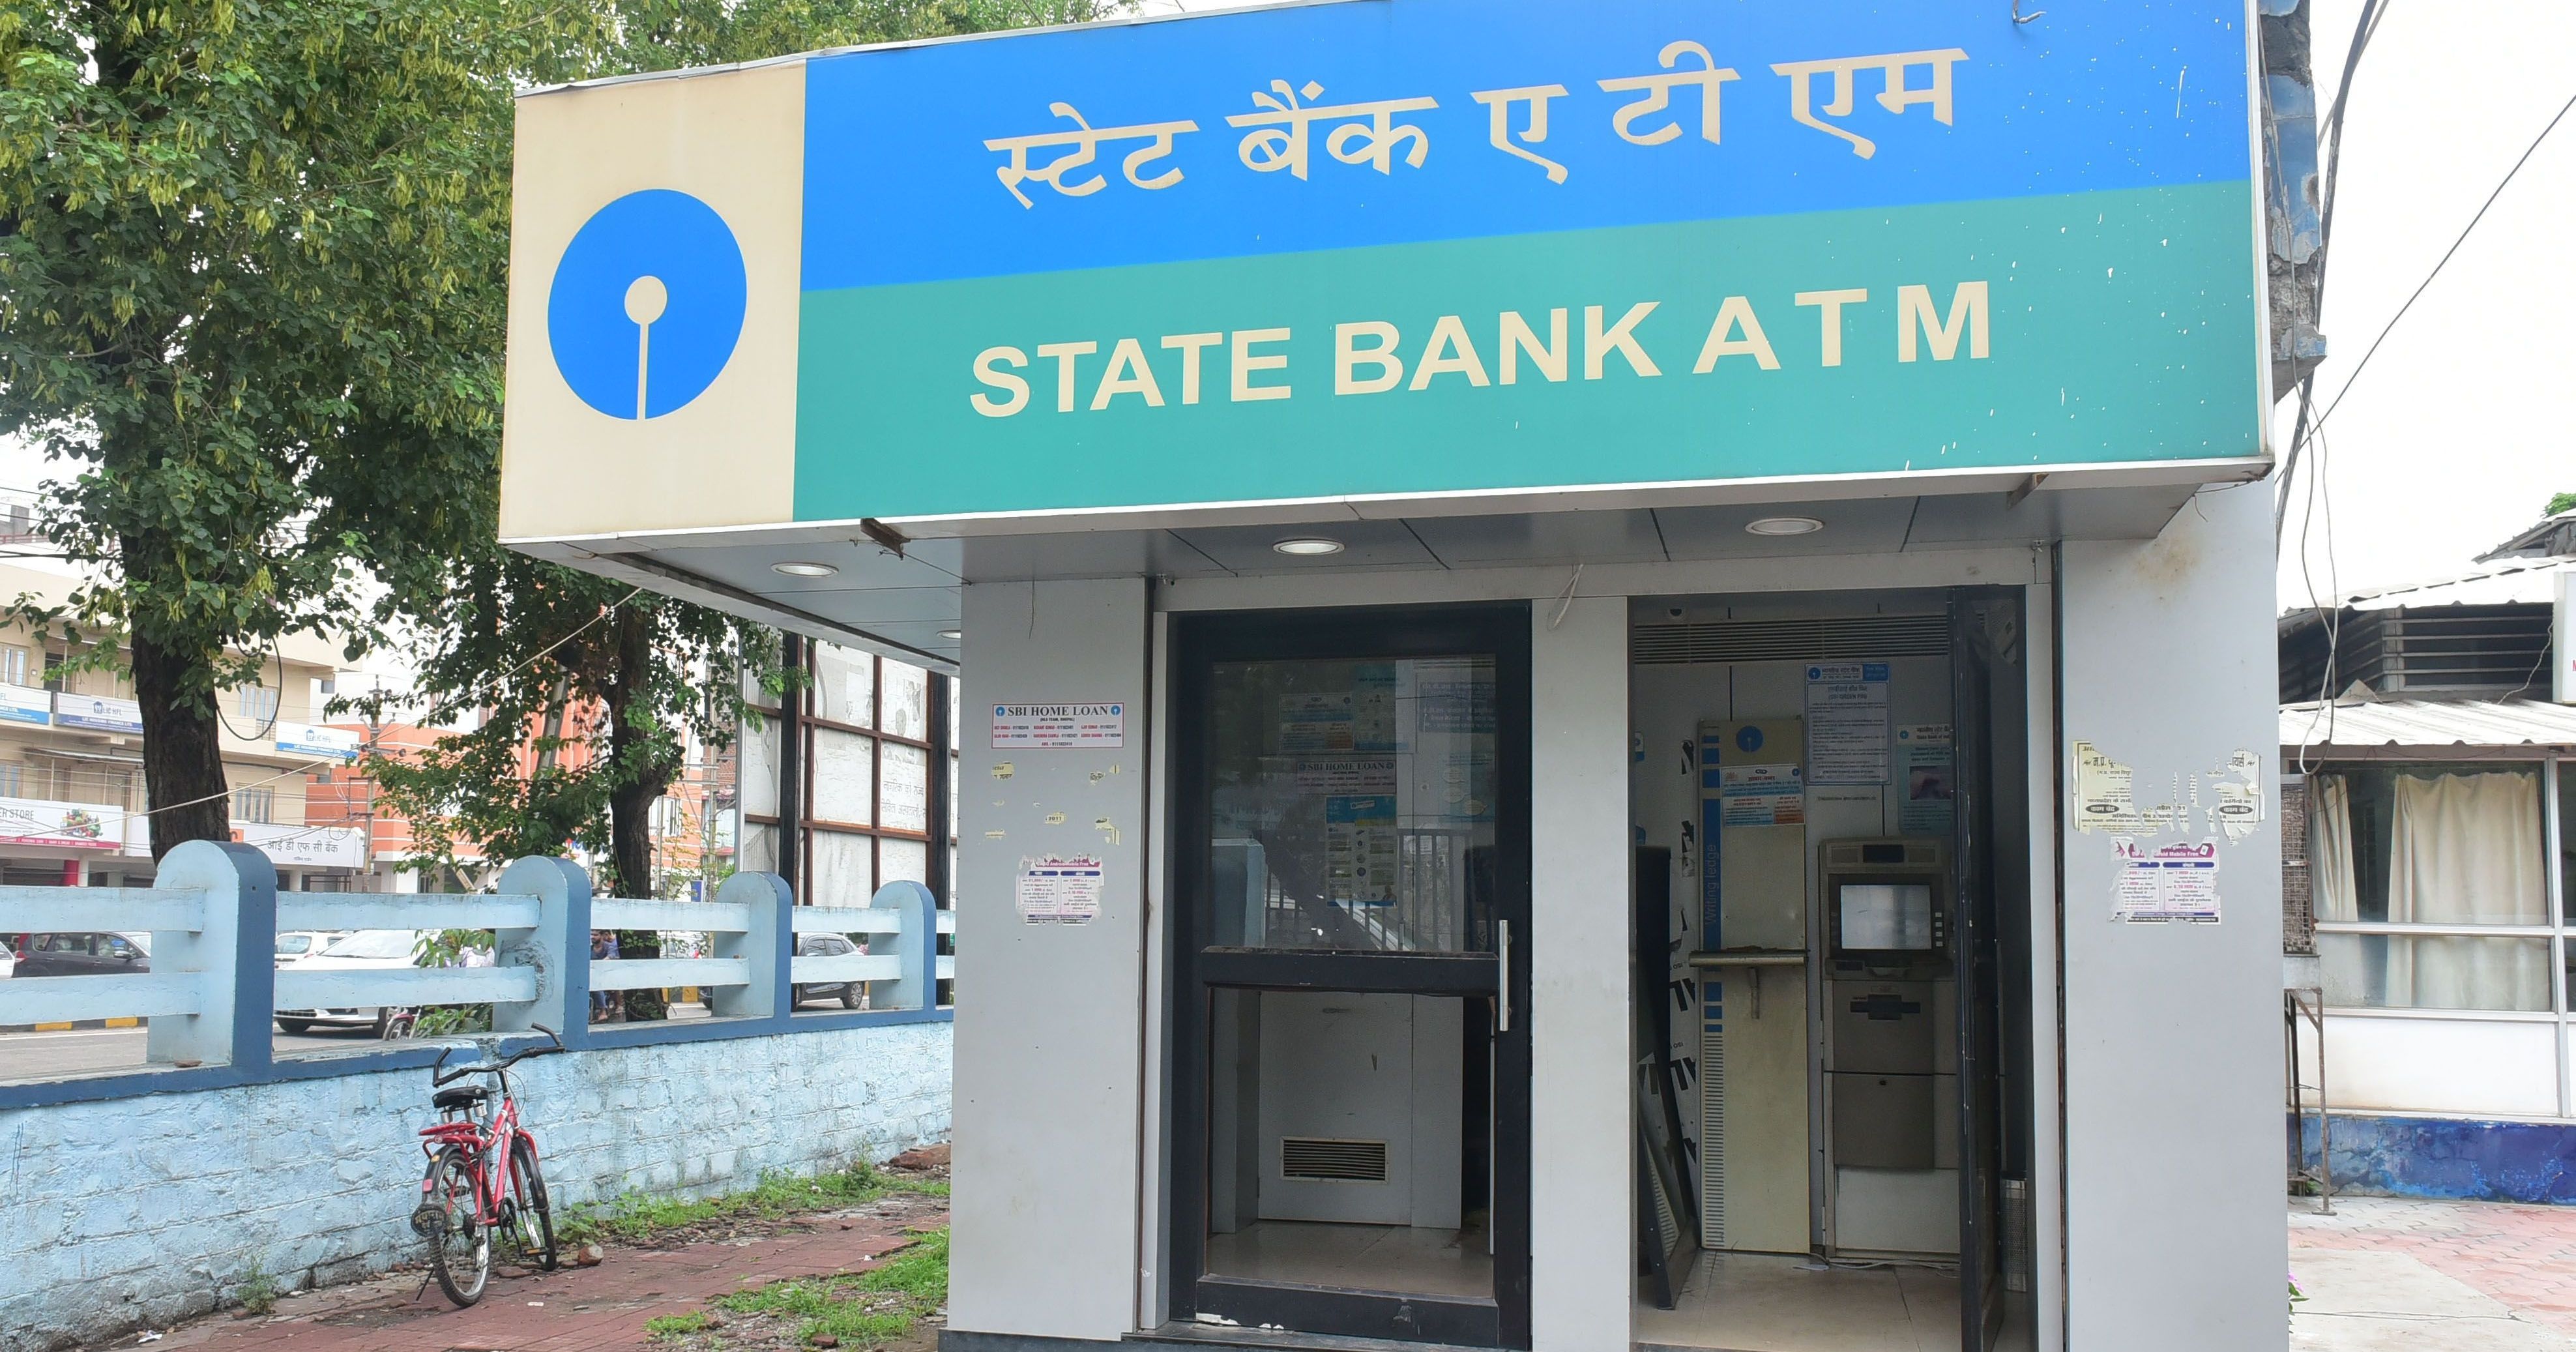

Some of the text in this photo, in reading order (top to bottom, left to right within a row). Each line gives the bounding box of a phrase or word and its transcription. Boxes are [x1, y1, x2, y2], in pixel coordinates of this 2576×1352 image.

[983, 39, 1970, 210] स्टेट बैंक ए टी एम
[969, 326, 1293, 419] STATE
[1334, 301, 1663, 396] BANK
[1008, 706, 1108, 716] SBI HOME LOAN
[9, 809, 35, 819] STORE
[267, 838, 339, 853] आई डी एफ सी बैंक
[1705, 844, 1720, 928] Writing ledge
